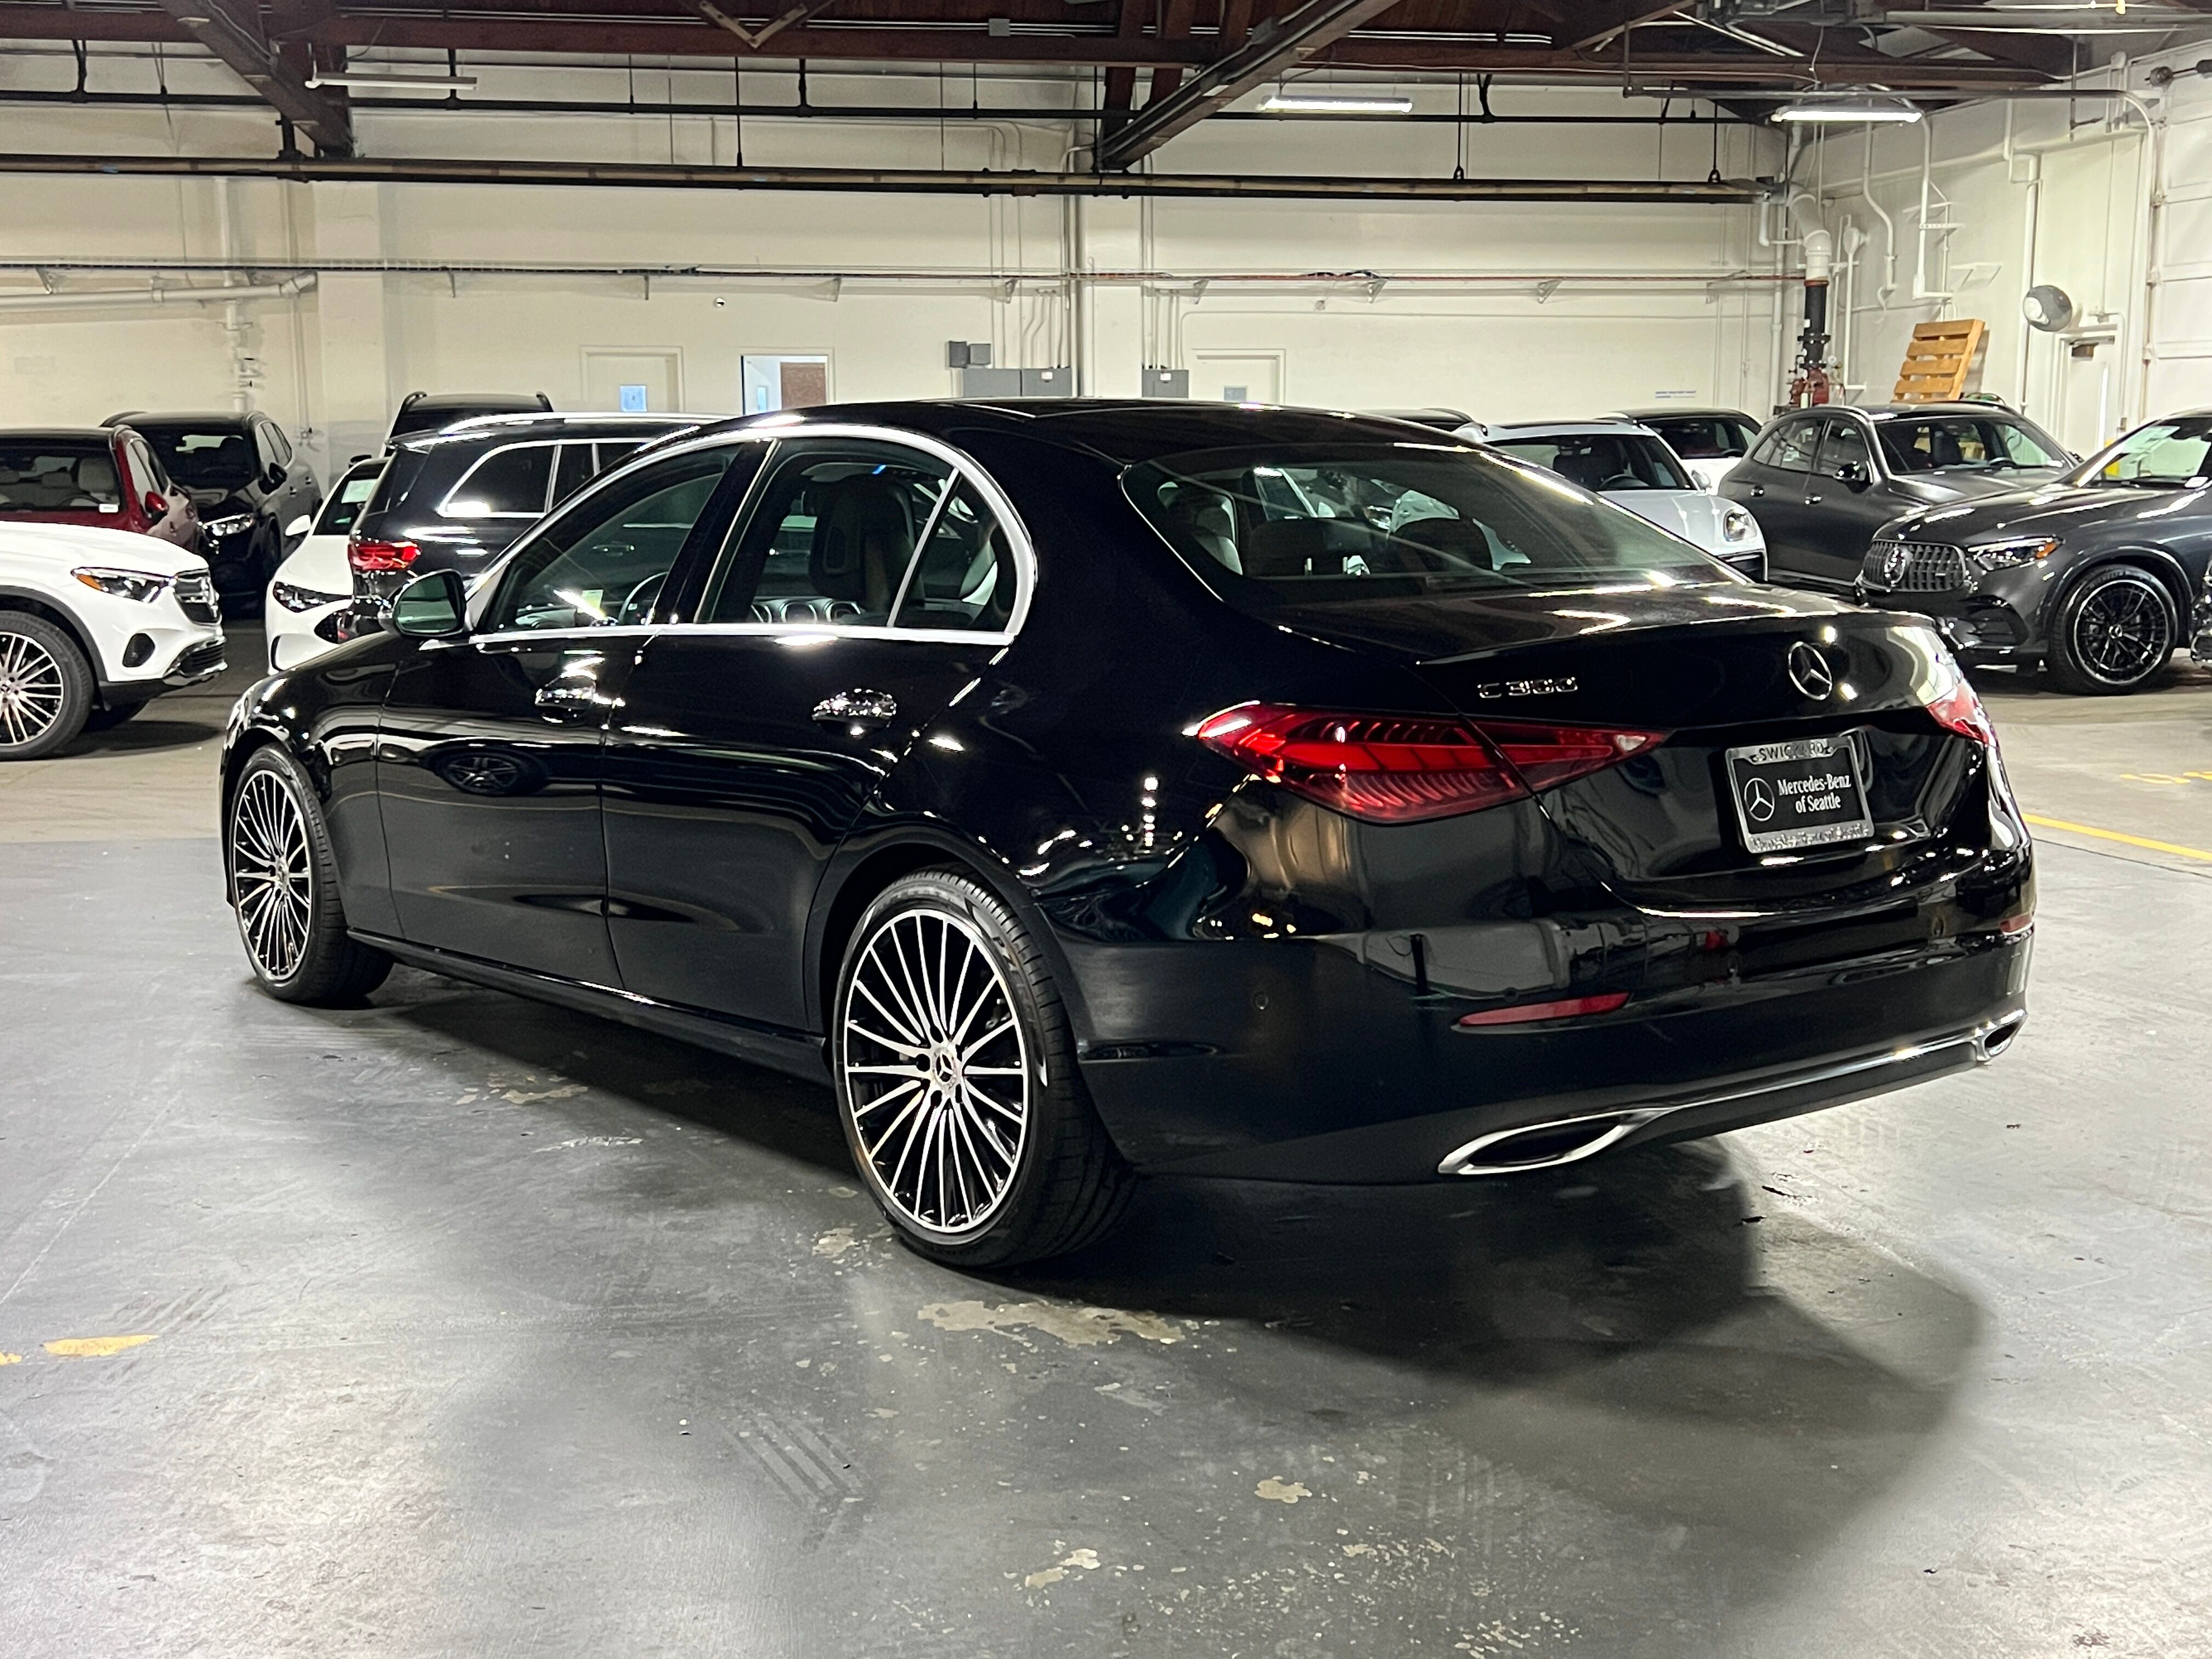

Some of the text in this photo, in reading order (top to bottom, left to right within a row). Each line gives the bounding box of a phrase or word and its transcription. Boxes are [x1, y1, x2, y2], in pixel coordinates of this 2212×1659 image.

[1477, 677, 1578, 698] C 300
[1777, 773, 1852, 796] Mercedes-Benz
[1795, 792, 1841, 814] of Seattle
